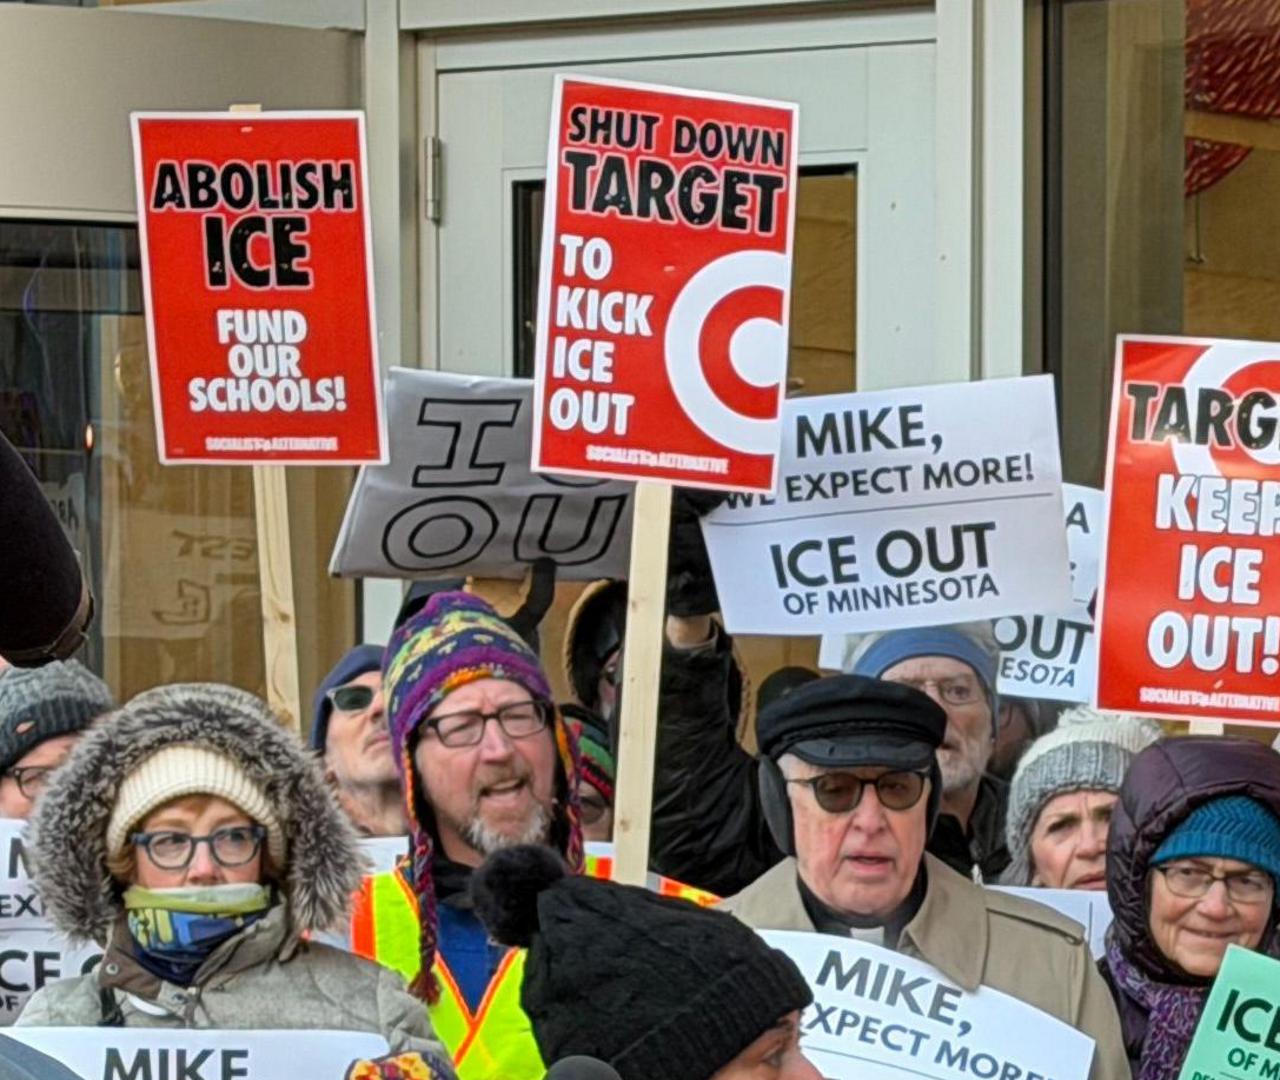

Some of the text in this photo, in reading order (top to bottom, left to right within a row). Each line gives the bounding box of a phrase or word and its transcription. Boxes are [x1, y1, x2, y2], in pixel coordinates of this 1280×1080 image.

[569, 107, 785, 167] SHUT DOWN
[153, 163, 354, 209] ABOLISH
[564, 152, 783, 232] TARGET
[205, 216, 311, 287] ICE
[560, 234, 613, 280] TO
[217, 309, 308, 344] FUND
[557, 286, 653, 337] KICK
[228, 344, 302, 378] OUR
[553, 337, 614, 383] ICE
[188, 376, 348, 412] SCHOOLS!
[549, 388, 634, 436] OUT
[796, 405, 943, 457] MIKE,
[785, 464, 911, 502] EXPECT
[923, 453, 1034, 490] MORE!
[770, 522, 995, 588] ICE OUT
[1178, 544, 1264, 604] ICE
[783, 573, 999, 615] OF MINNESOTA
[1001, 658, 1075, 688] ESOTA
[815, 950, 972, 1037] MIKE,
[806, 1002, 930, 1056] XPECT
[1227, 1047, 1259, 1072] OF
